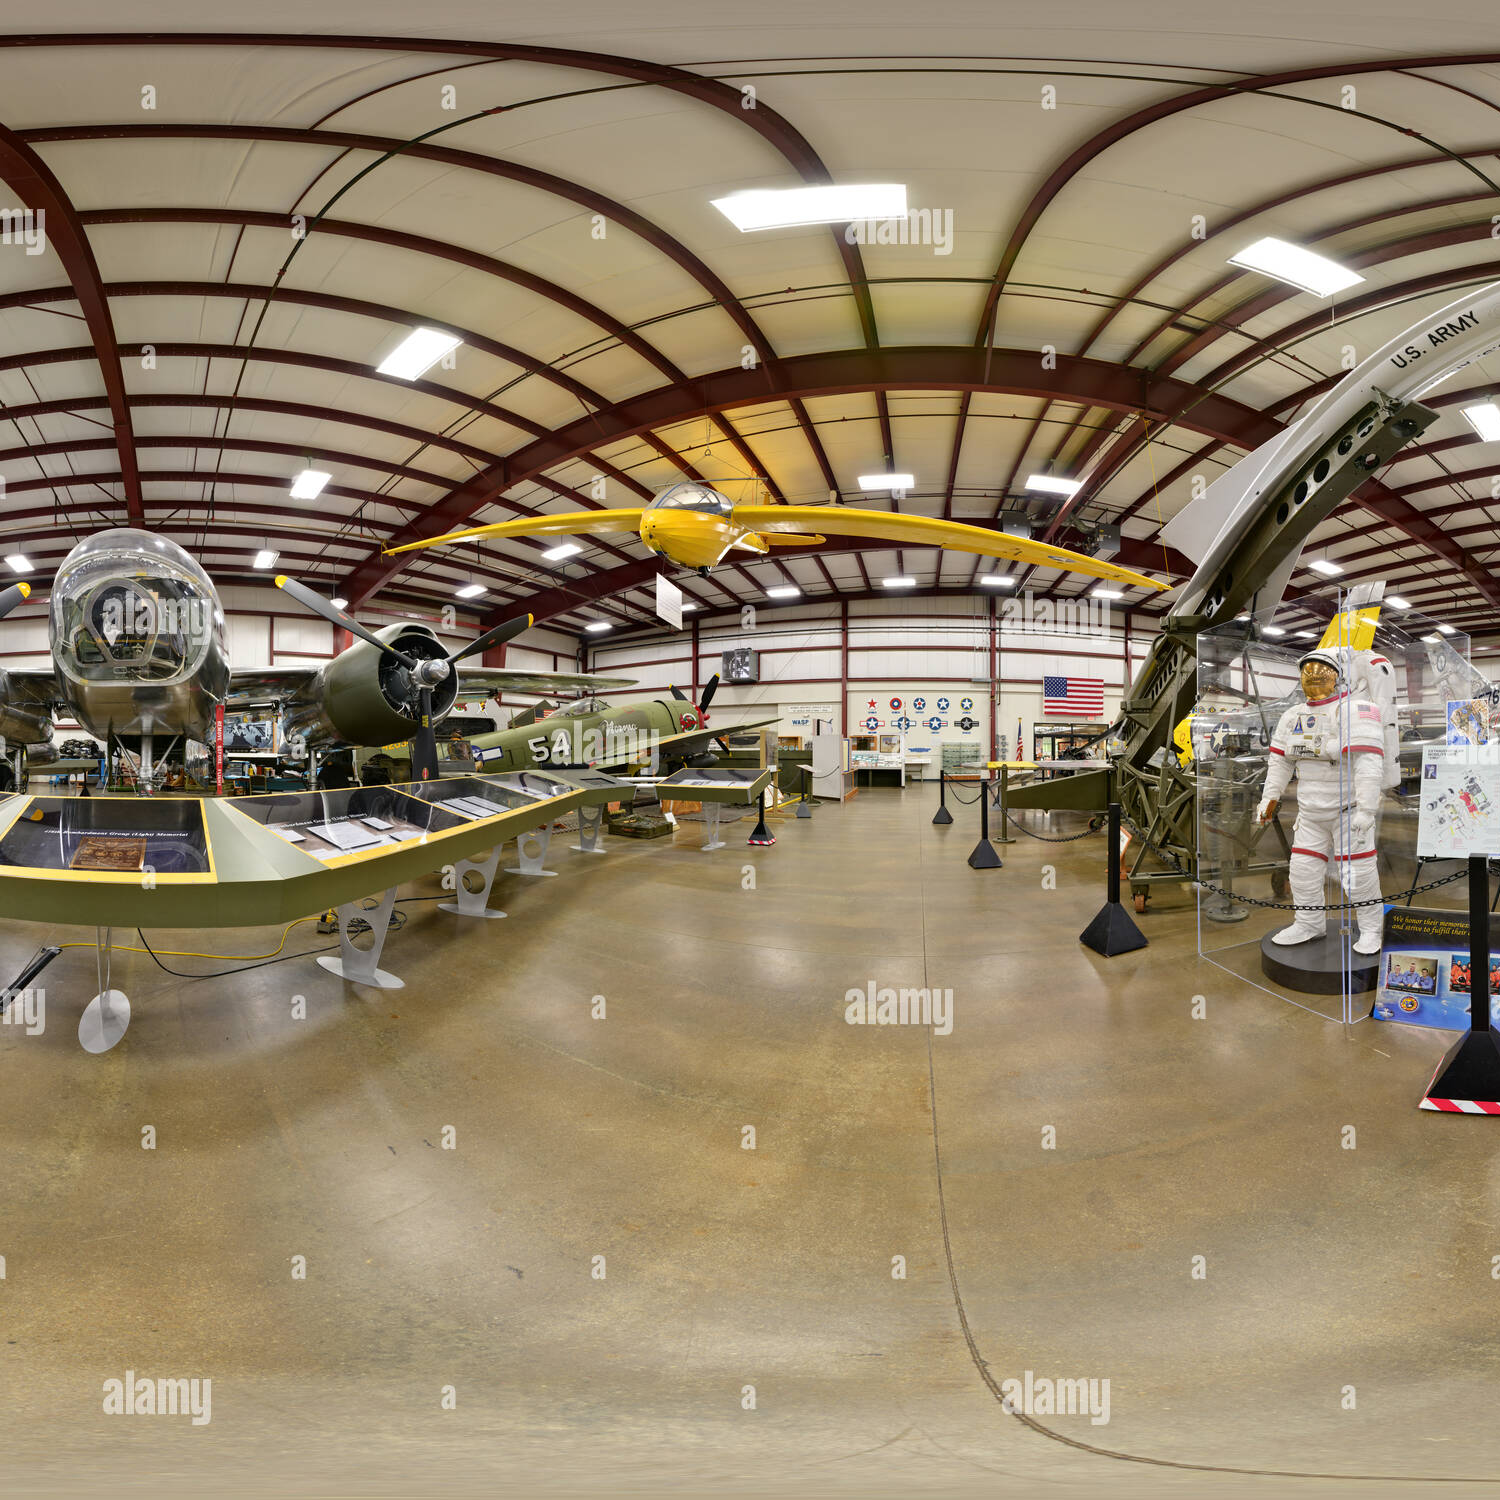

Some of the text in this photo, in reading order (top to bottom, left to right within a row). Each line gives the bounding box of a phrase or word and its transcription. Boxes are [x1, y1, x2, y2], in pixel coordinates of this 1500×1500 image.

[1390, 346, 1427, 369] U.S.
[1427, 310, 1480, 347] ARMY
[600, 720, 638, 736] Norma
[528, 732, 572, 762] 54
[1393, 915, 1403, 923] We
[1405, 916, 1423, 925] honor
[1424, 917, 1439, 926] their
[1405, 924, 1422, 932] strive
[1430, 926, 1451, 936] fulfill
[1452, 928, 1467, 936] their
